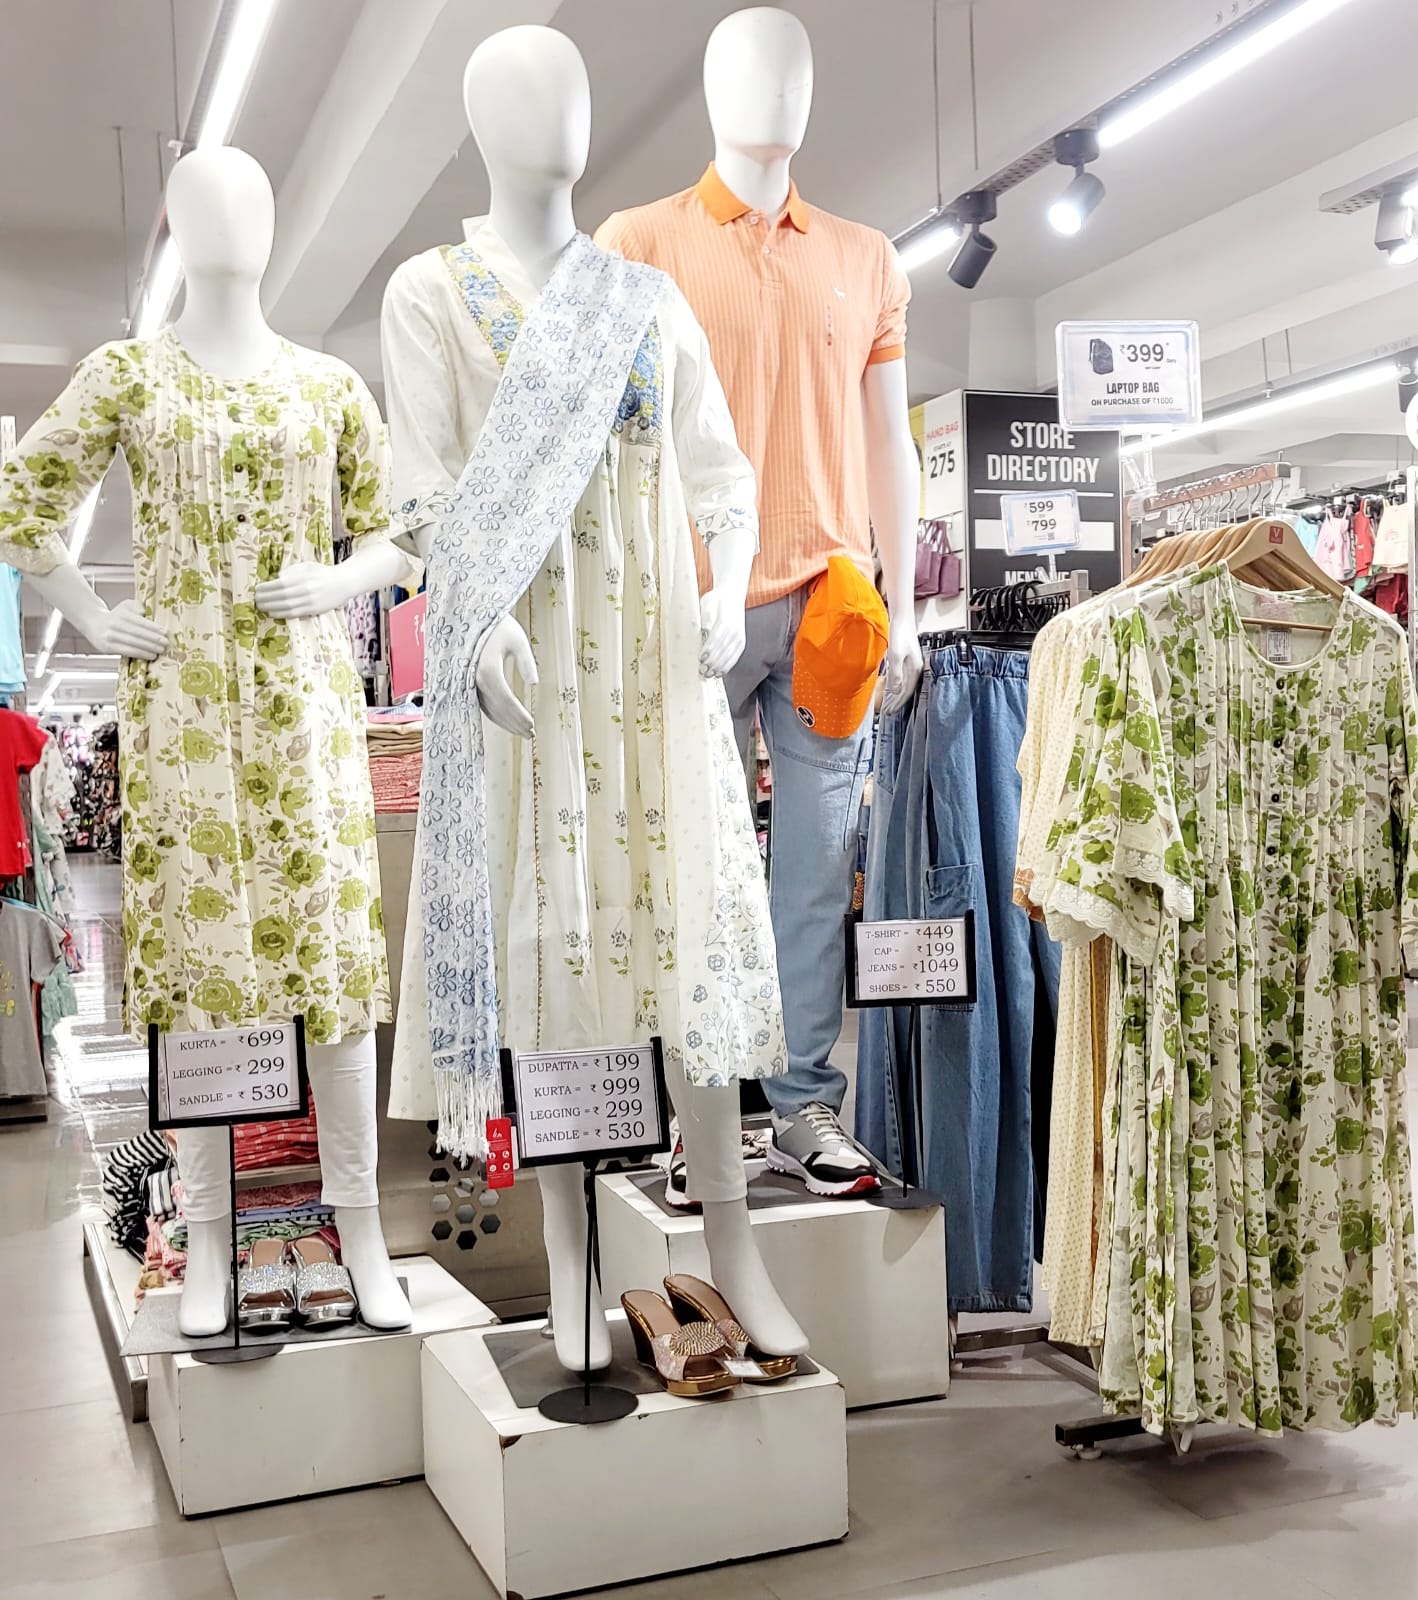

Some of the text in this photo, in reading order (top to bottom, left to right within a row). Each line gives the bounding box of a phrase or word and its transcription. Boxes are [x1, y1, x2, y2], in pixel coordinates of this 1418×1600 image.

[1106, 382, 1159, 394] LAPTOP BAG
[1103, 397, 1140, 406] PURCHASE
[945, 420, 959, 434] BAG
[1010, 421, 1076, 449] STORE
[987, 454, 1100, 484] DIRECTORY
[865, 930, 901, 939] T-SHIRT
[874, 947, 892, 956] CAP
[868, 963, 897, 973] JEANS
[869, 984, 900, 993] SHOES
[180, 1039, 217, 1051] KURTA
[173, 1065, 223, 1079] LEGGING
[528, 1060, 579, 1073] DUPATTA
[534, 1085, 572, 1097] KURTA
[179, 1092, 223, 1106] SANDLE
[530, 1107, 581, 1120] LEGGING
[535, 1130, 580, 1142] SANDLE
